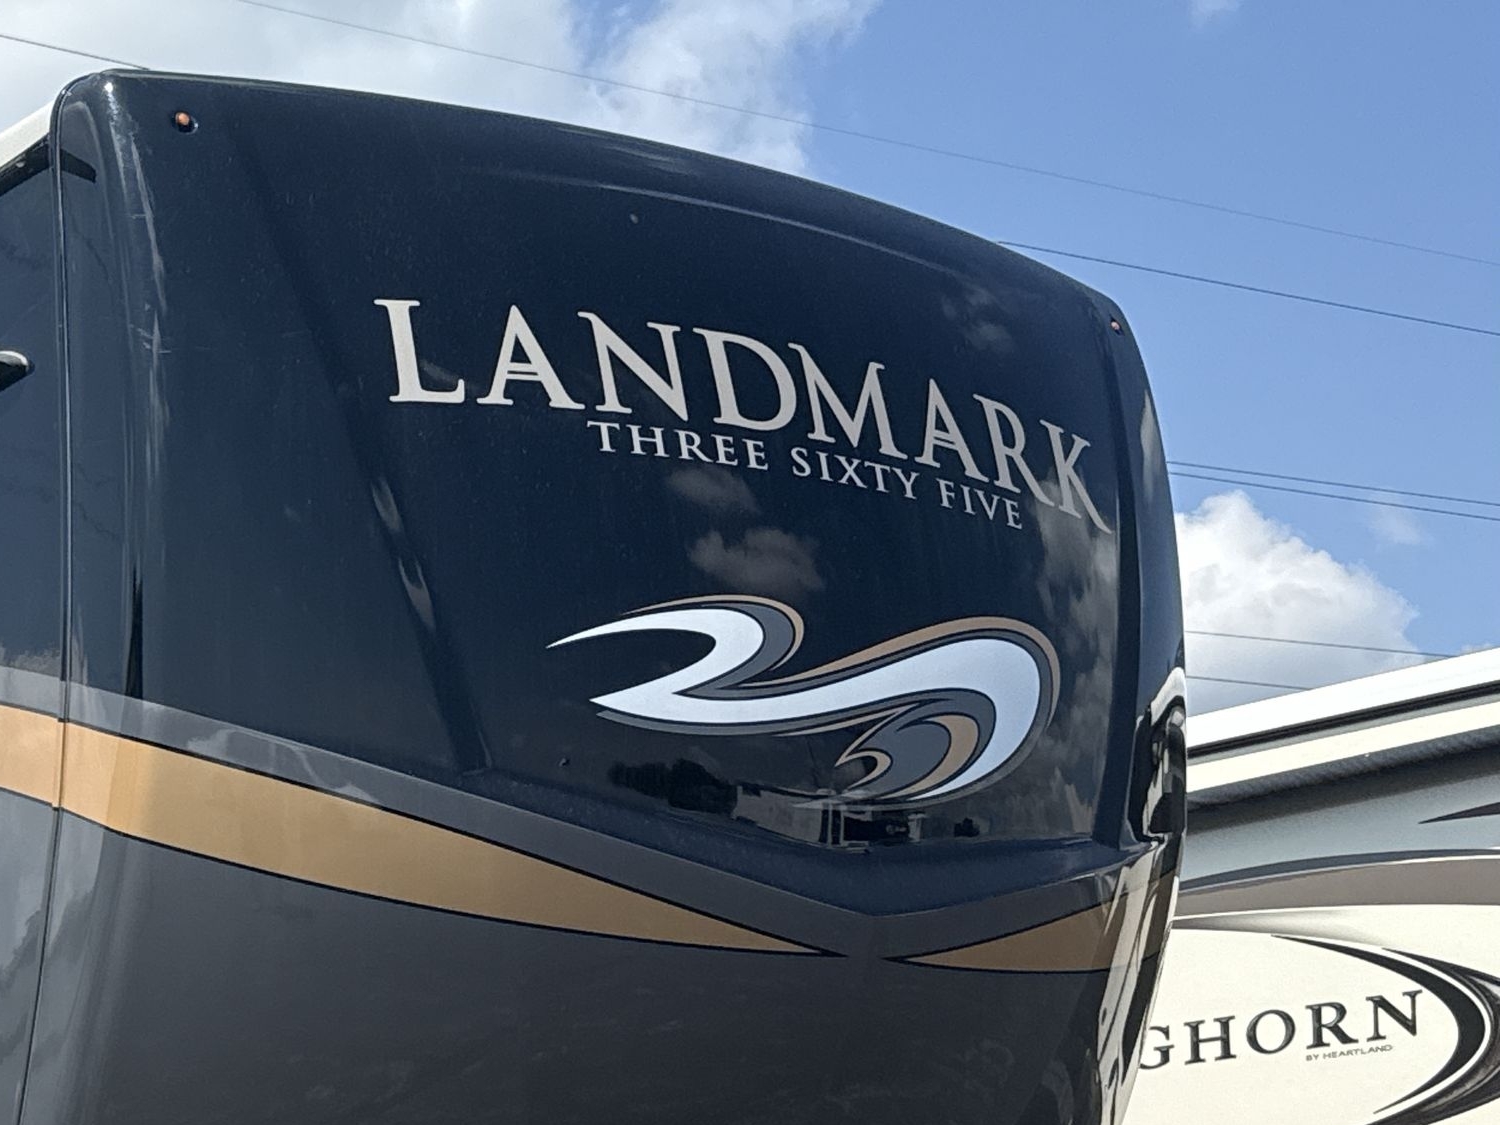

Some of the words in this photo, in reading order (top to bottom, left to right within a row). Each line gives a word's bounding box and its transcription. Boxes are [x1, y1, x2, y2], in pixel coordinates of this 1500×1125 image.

[374, 298, 1112, 534] LANDMARK
[587, 420, 769, 470] THREE
[791, 446, 920, 501] SIXTY
[934, 478, 1023, 530] FIVE
[1139, 989, 1423, 1069] GHORN
[1305, 1053, 1320, 1062] BY
[1322, 1044, 1393, 1060] HEARTLAND
